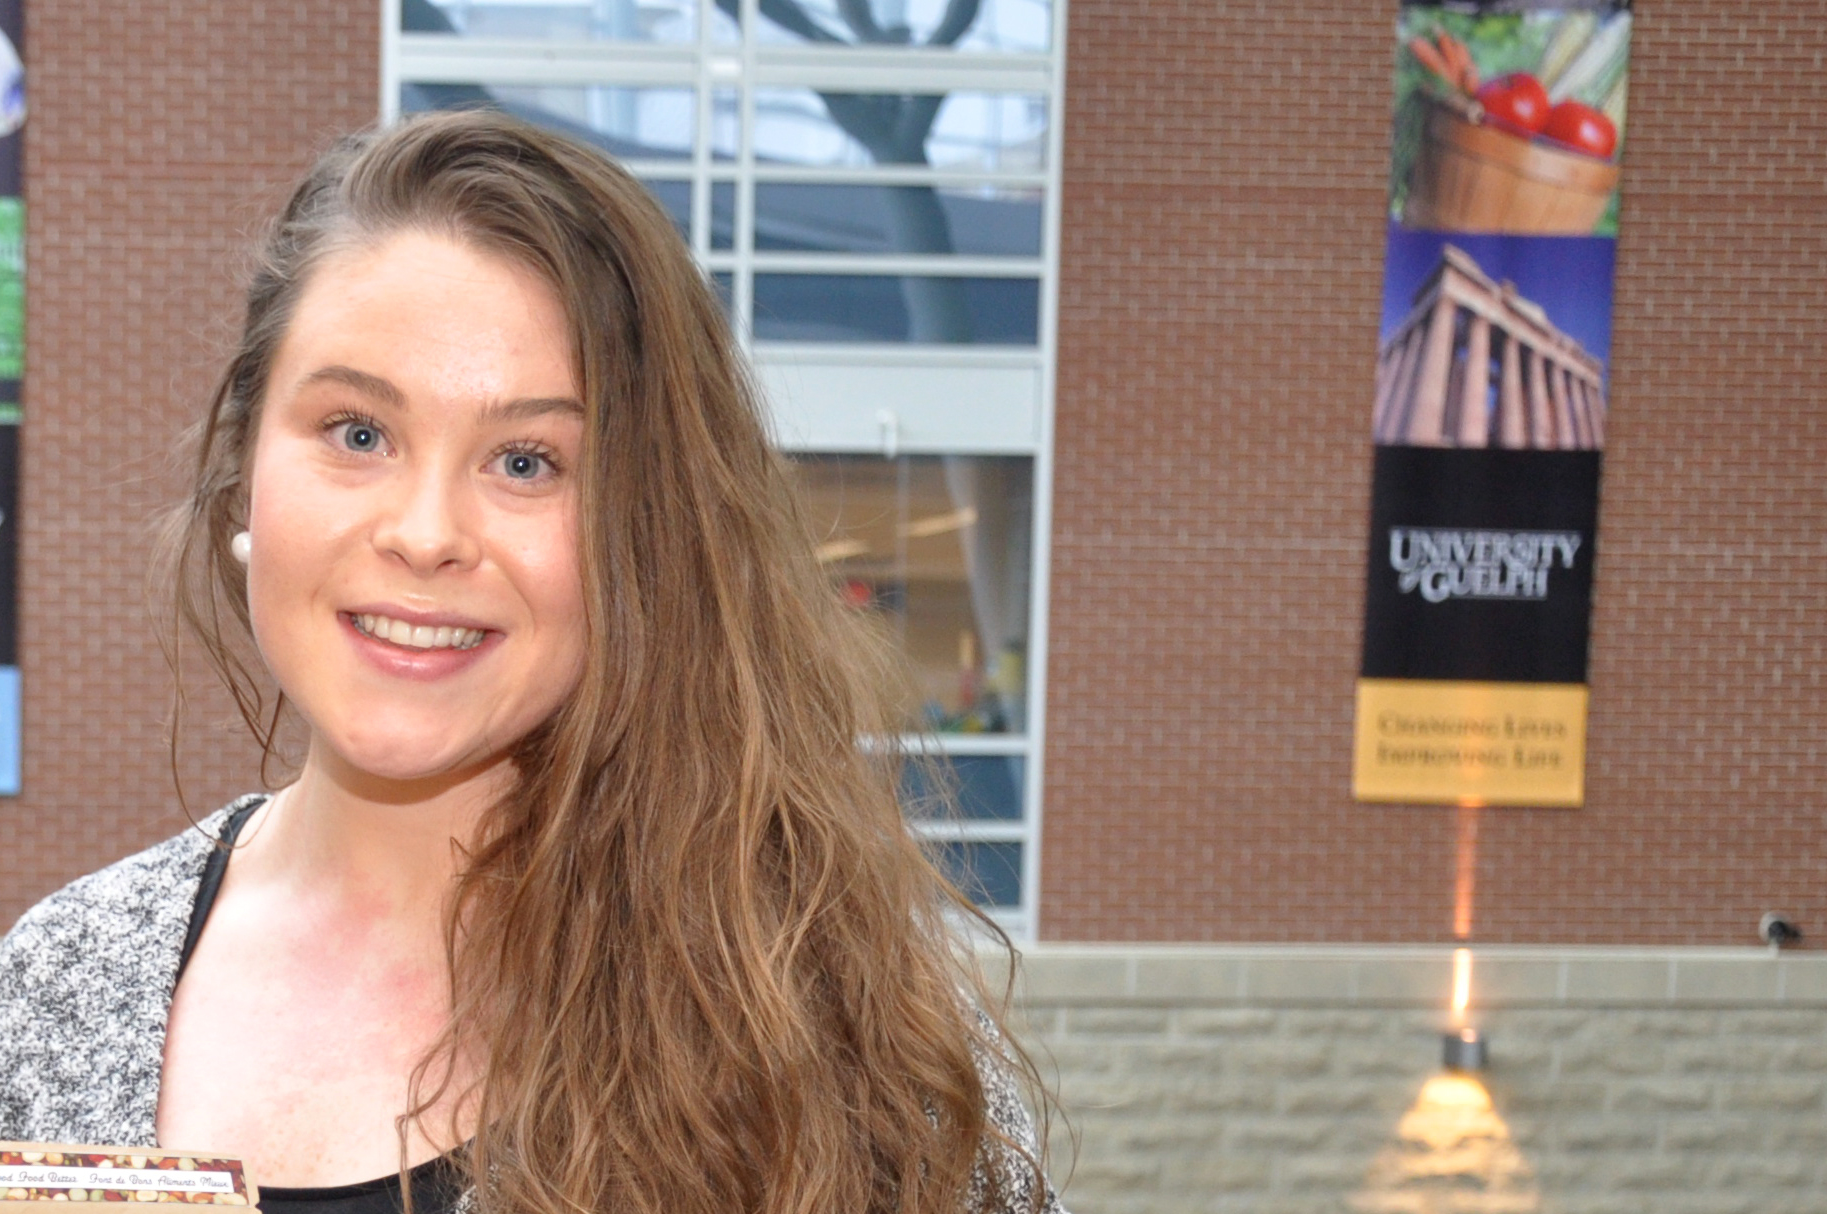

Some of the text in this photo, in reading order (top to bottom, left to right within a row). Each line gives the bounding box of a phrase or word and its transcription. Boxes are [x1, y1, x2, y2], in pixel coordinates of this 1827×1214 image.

[1388, 527, 1582, 571] UNIVERSITY
[1420, 563, 1550, 603] GUELPH
[18, 1171, 45, 1182] Food
